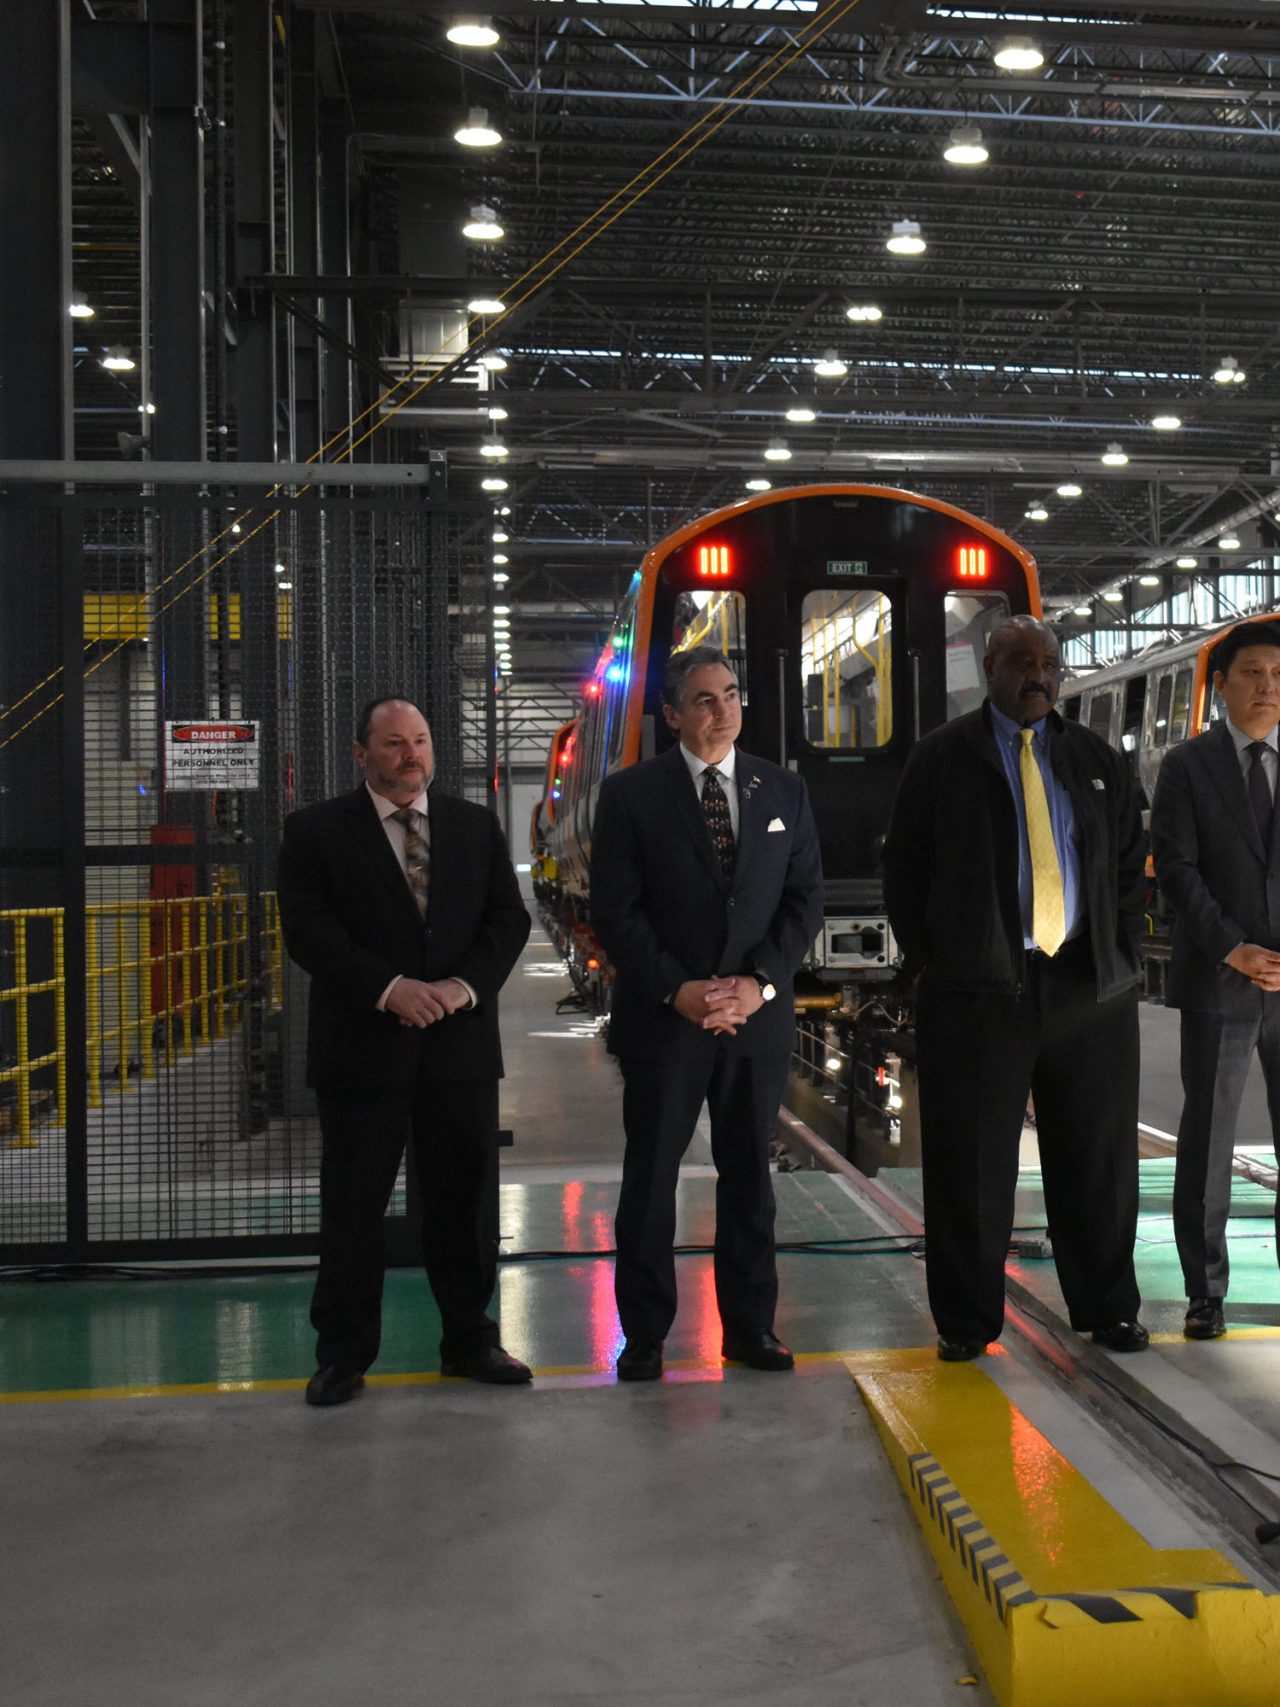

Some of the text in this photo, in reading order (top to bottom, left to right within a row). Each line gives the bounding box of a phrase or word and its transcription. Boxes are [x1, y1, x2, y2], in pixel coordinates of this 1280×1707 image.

[832, 562, 852, 573] EXIT
[191, 730, 236, 740] DANGER
[183, 747, 243, 756] AUTHORIZED
[172, 759, 254, 768] PERSONNEL ONLY
